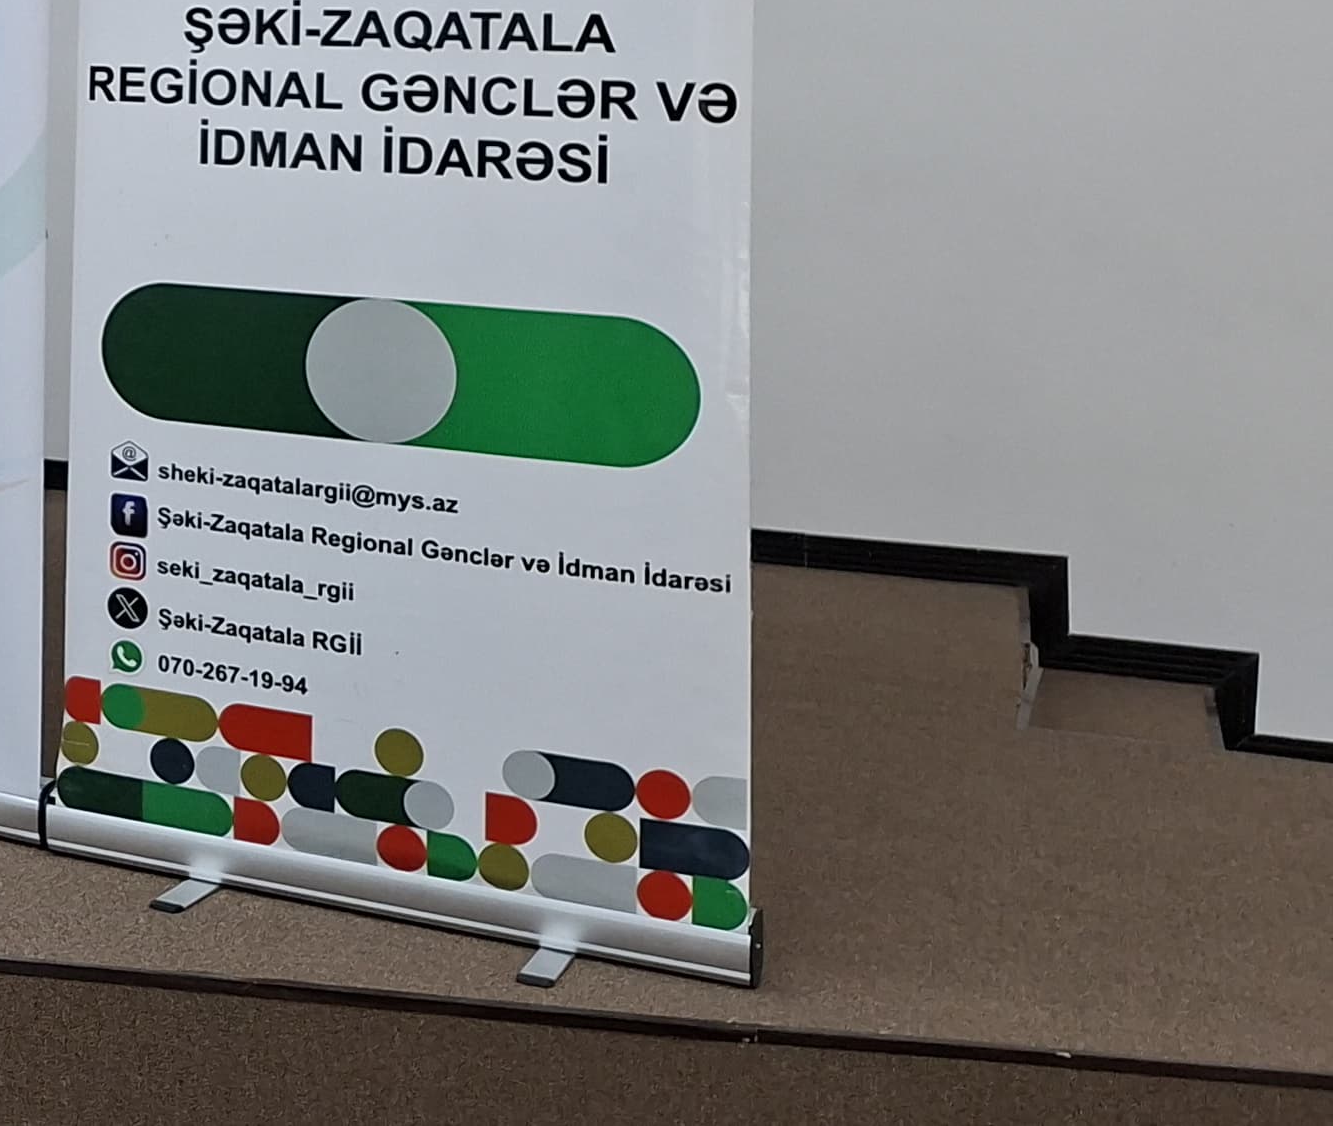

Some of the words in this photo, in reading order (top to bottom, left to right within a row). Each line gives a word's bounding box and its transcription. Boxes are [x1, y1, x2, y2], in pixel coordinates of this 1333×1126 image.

[184, 0, 616, 53] ŞƏKİ-ZAQATALA
[89, 62, 343, 110] REGİONAL
[361, 73, 638, 120] GƏNCLƏR
[656, 81, 737, 124] VƏ
[200, 121, 362, 172] İDMAN
[383, 127, 607, 184] İDARƏSİ
[158, 463, 458, 514] sheki-zaqatalargii@mys.az
[157, 507, 304, 542] Şəki-Zaqatala
[311, 526, 413, 556] Regional
[421, 539, 515, 570] Gənclər
[520, 556, 551, 574] və
[558, 551, 635, 584] İdman
[644, 561, 730, 593] İdarəsi
[157, 559, 353, 603] seki_zaqatala_rgii
[158, 608, 304, 647] Şəki-Zaqatala
[158, 654, 308, 695] 070-267-19-94
